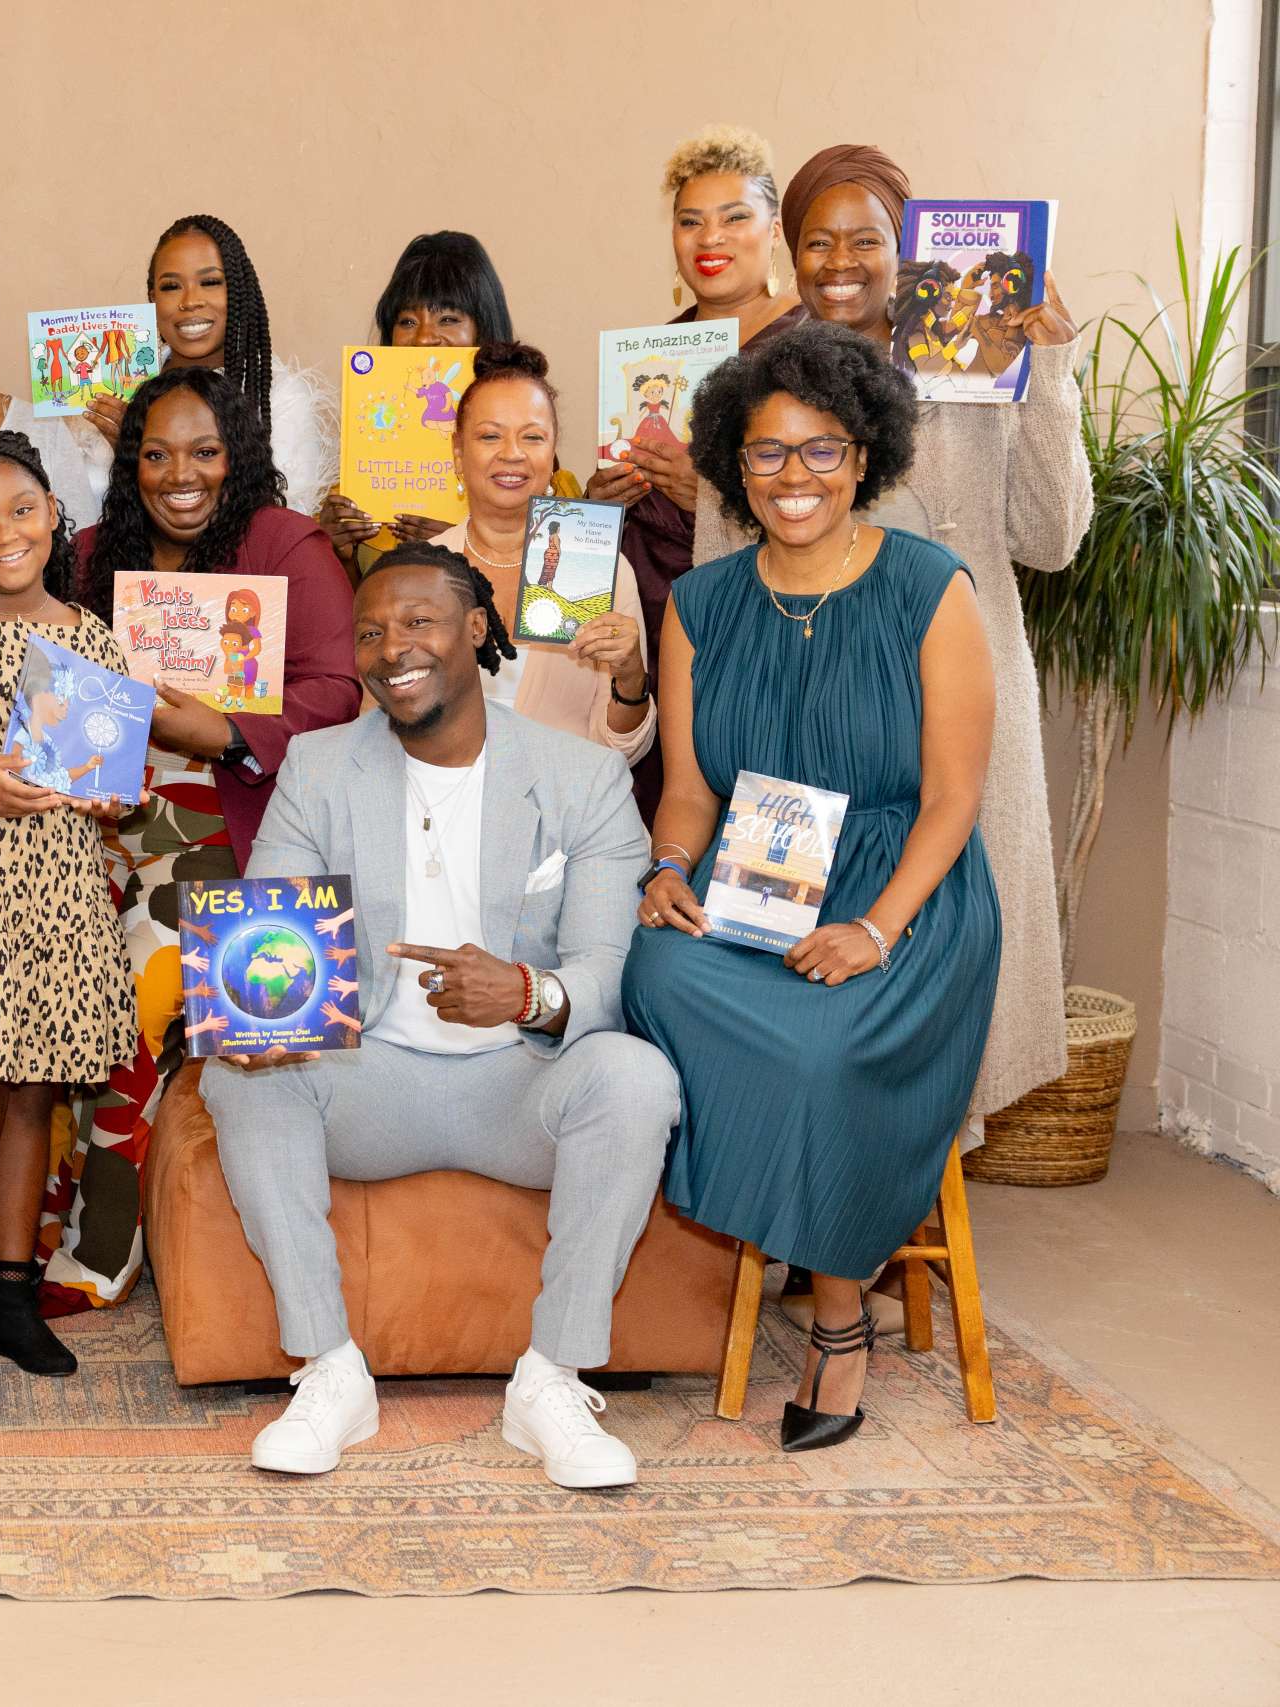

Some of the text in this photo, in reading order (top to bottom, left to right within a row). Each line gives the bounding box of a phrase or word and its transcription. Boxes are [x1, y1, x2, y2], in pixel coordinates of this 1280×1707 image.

[931, 213, 1006, 228] SOULFUL
[931, 232, 1000, 247] COLOUR
[40, 313, 79, 328] Mommy
[81, 311, 107, 321] Lives
[48, 320, 139, 336] Daddy Lives There
[616, 331, 729, 353] The Amazing Zoe
[358, 460, 454, 474] LITTLE HOP
[371, 478, 448, 491] BIG HOPE
[139, 578, 192, 605] Knots
[163, 609, 208, 630] laces
[128, 624, 180, 651] Knots
[159, 650, 216, 677] tummy
[735, 814, 826, 858] SCHOOL
[190, 885, 339, 917] YES, I AM
[222, 1038, 257, 1047] Illustrated
[258, 1038, 267, 1047] by
[235, 1031, 261, 1039] Written
[262, 1030, 270, 1039] by
